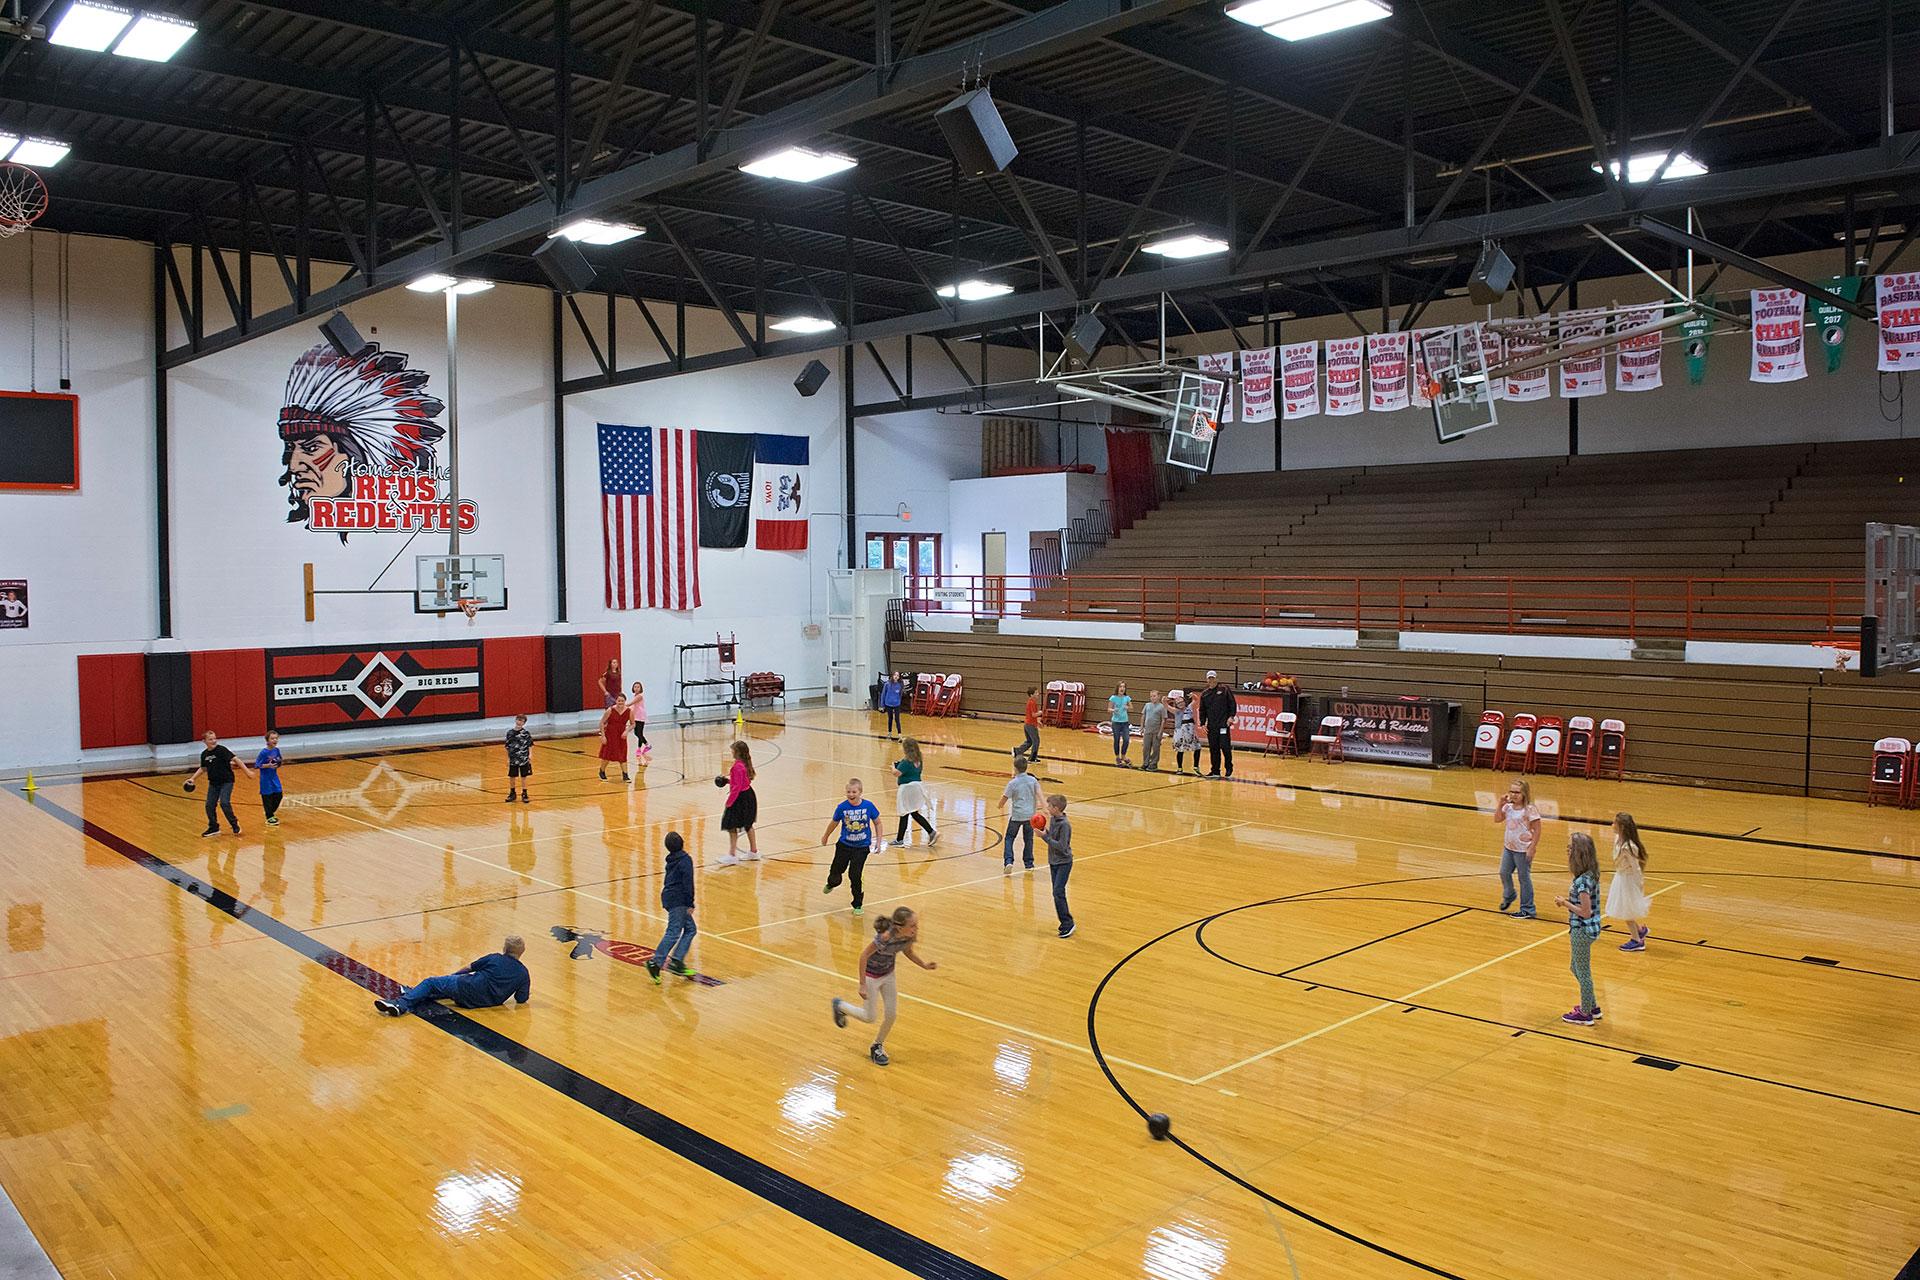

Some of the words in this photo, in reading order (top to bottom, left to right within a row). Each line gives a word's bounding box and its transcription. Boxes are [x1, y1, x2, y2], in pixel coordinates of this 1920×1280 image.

[1884, 275, 1920, 287] 201
[1824, 287, 1842, 295] OLF
[1881, 291, 1920, 307] BASEBA
[1755, 305, 1801, 321] FOOTBALL
[1824, 315, 1842, 324] 2017
[1881, 308, 1920, 328] STAT
[1756, 320, 1801, 341] STATE
[1882, 330, 1920, 345] QUALIFI
[1757, 339, 1800, 357] QUALIFIER
[1328, 356, 1360, 368] FOOTBALL
[1370, 352, 1406, 365] FOOTBALL
[1620, 351, 1660, 368] QUALIFIER
[1328, 367, 1360, 383] STATE
[1371, 362, 1406, 380] STATE
[336, 456, 397, 478] Home
[399, 459, 424, 486] of
[355, 475, 437, 502] REDS
[765, 481, 773, 504] IOWA
[387, 491, 407, 513] &
[312, 500, 476, 530] REDETTES
[277, 684, 348, 696] CENTERVILLE
[435, 677, 459, 685] REDS
[1236, 704, 1266, 714] AMOUS
[1334, 702, 1431, 721] CENTERVILLE
[1353, 718, 1377, 729] Reds
[1379, 720, 1387, 730] &
[1390, 720, 1429, 732] Redettes
[1370, 732, 1397, 741] CHS
